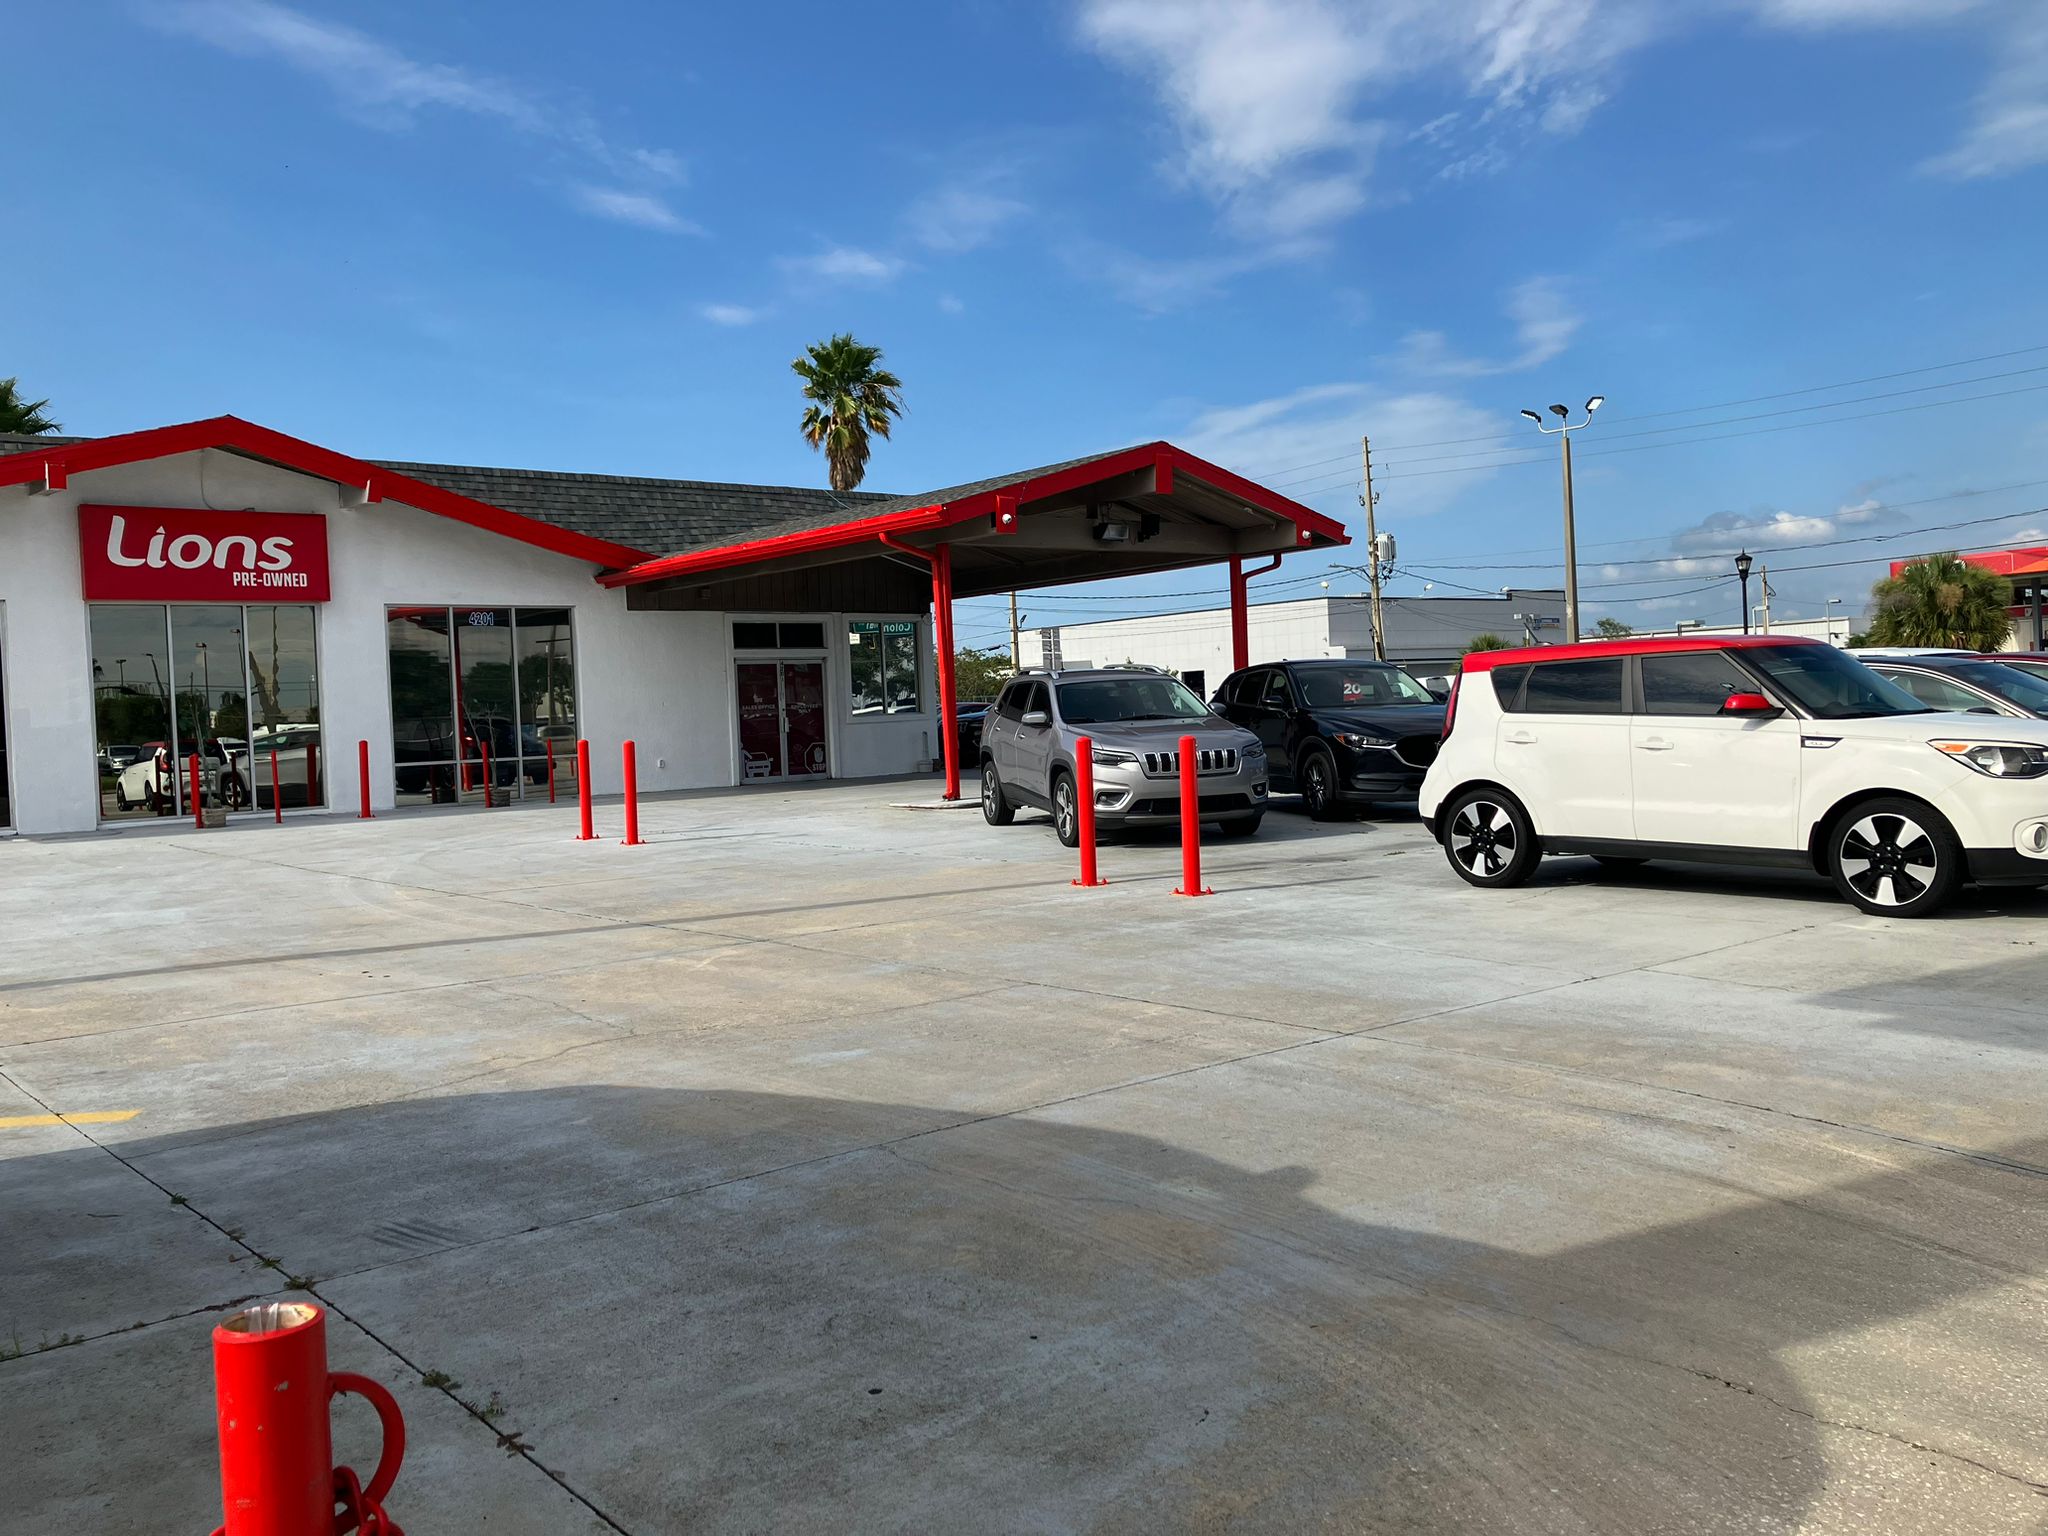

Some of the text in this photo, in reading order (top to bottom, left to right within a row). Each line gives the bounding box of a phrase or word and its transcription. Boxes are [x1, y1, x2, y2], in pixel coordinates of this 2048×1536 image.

[107, 515, 294, 571] Lions
[232, 571, 308, 588] PRE-OWNED
[468, 611, 494, 626] 4201
[812, 763, 826, 772] STOP
